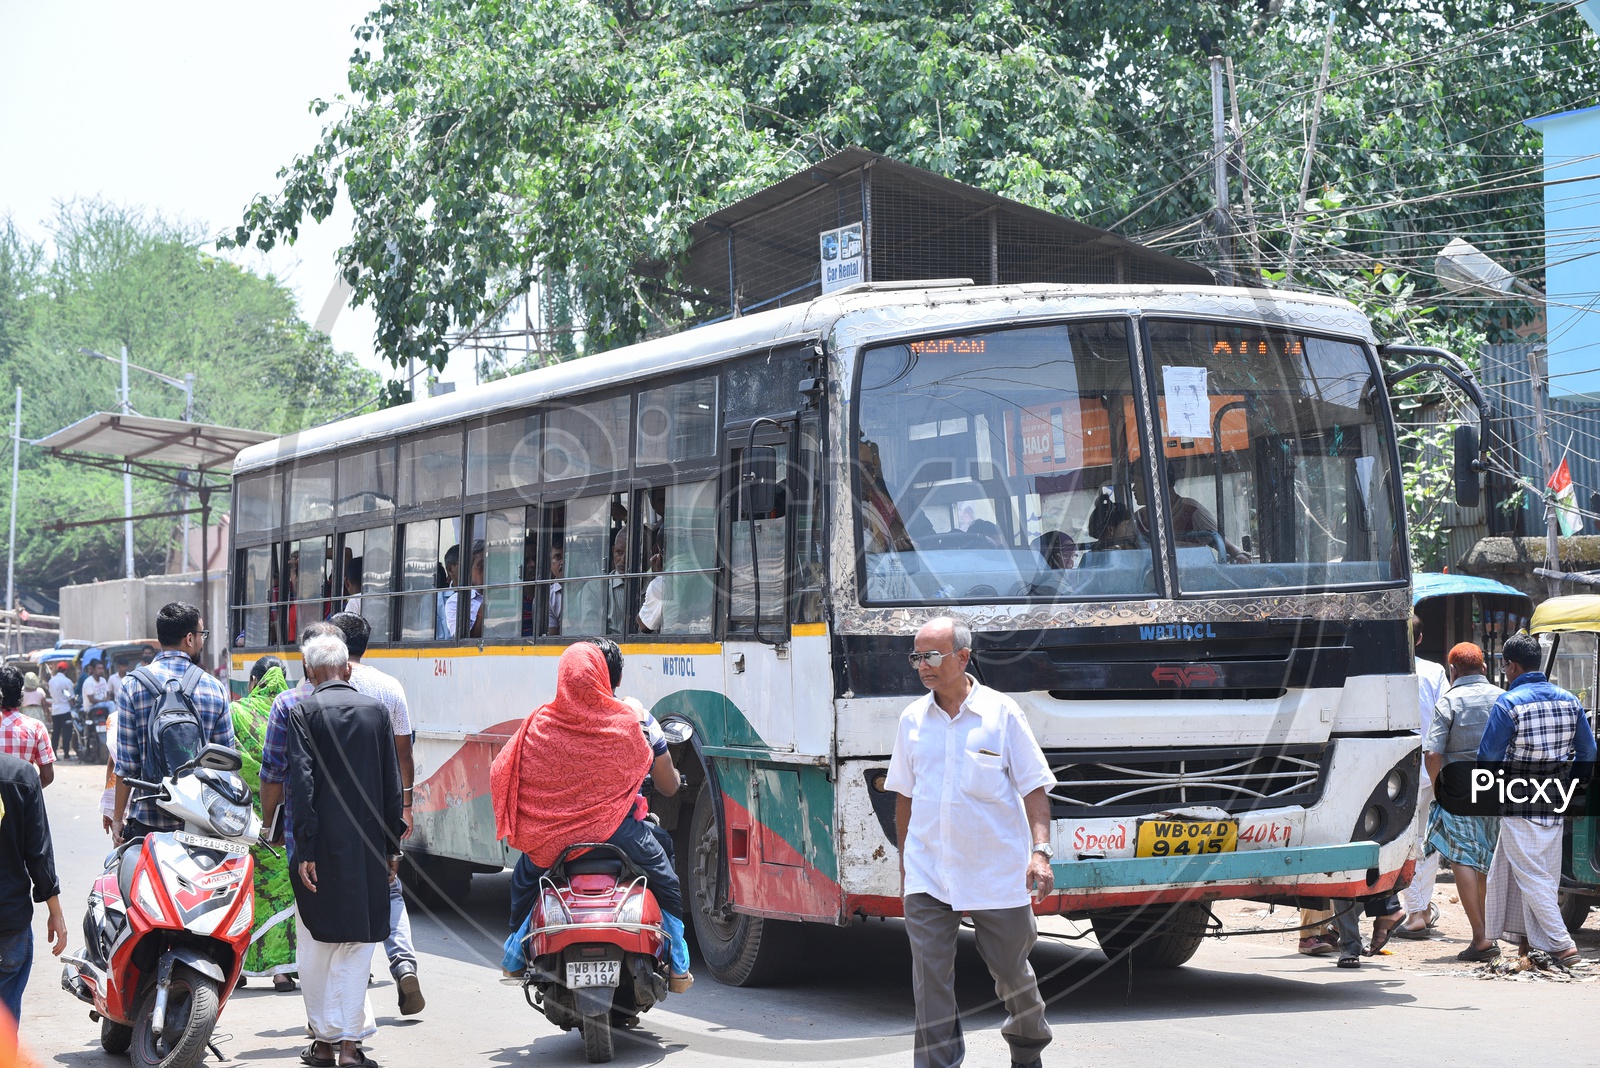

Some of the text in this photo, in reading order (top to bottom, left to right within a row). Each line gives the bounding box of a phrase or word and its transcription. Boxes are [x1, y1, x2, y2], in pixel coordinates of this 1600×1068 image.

[827, 260, 859, 282] Car Rental
[1139, 623, 1216, 640] WBTIDCL
[662, 656, 696, 676] WBTIDCL
[1073, 823, 1126, 851] Speed
[1151, 839, 1225, 856] 9415
[574, 962, 589, 974] WB
[574, 973, 615, 986] F 3194
